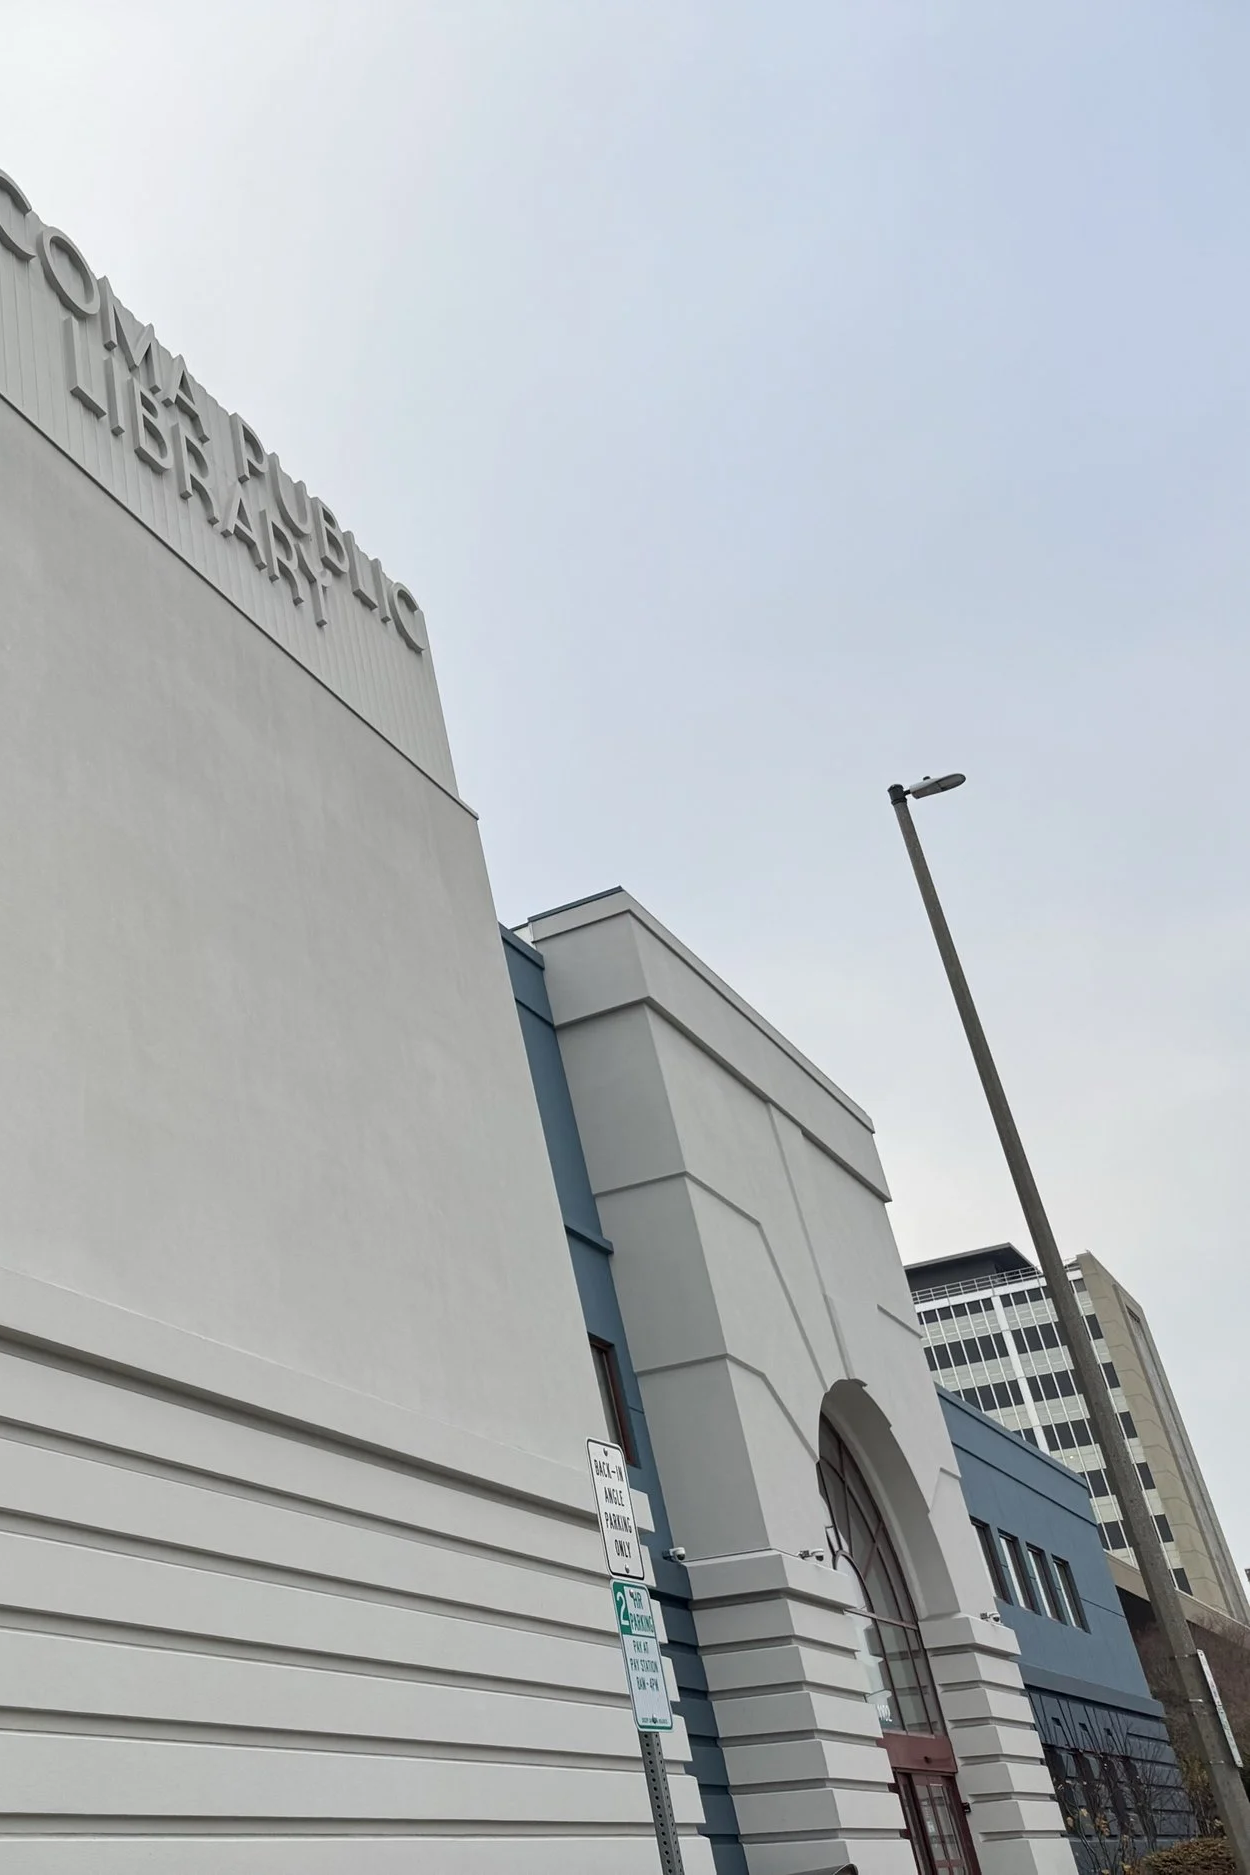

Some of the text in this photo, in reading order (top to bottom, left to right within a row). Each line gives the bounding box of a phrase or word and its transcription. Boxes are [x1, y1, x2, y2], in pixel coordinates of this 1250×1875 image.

[65, 315, 332, 627] LIBRARY
[230, 412, 428, 654] PUBLIC
[593, 1459, 624, 1482] BACK-IN
[604, 1486, 625, 1507] ANGLE
[604, 1511, 632, 1533] PARKING
[614, 1539, 632, 1558] ONLY
[616, 1591, 630, 1626] 2
[631, 1591, 644, 1610] HR
[630, 1612, 655, 1633] PARKING
[633, 1640, 649, 1654] PAY AT
[630, 1658, 659, 1673] PAY STATION
